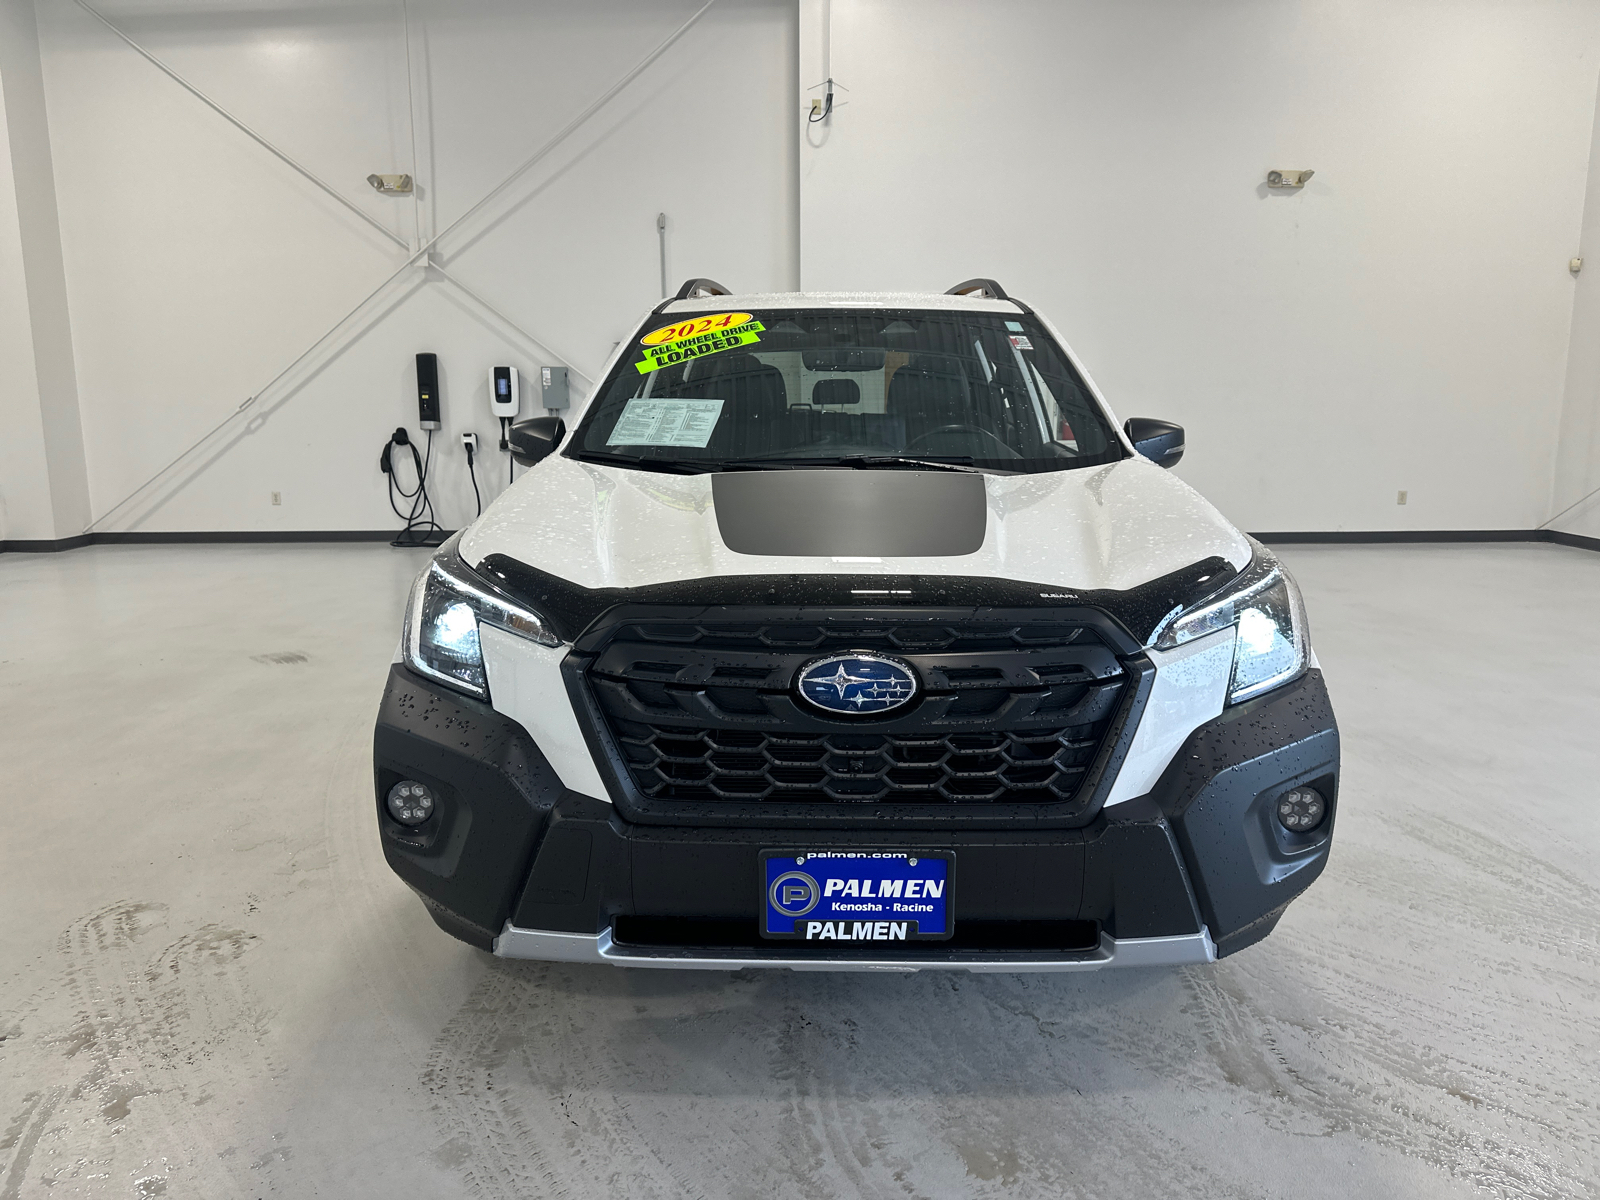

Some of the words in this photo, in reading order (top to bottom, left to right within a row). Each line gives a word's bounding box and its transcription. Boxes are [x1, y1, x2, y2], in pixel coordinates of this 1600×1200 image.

[660, 314, 733, 342] 2024
[650, 344, 674, 357] ALL
[676, 332, 719, 349] WHEEL
[721, 323, 758, 337] DRIVE
[656, 335, 743, 367] LOADED
[807, 851, 907, 859] palmen.com
[783, 885, 811, 904] P
[823, 878, 945, 898] PALMEN
[831, 902, 883, 912] Kenosha
[893, 903, 934, 912] Racine
[806, 921, 908, 940] PALMEN
